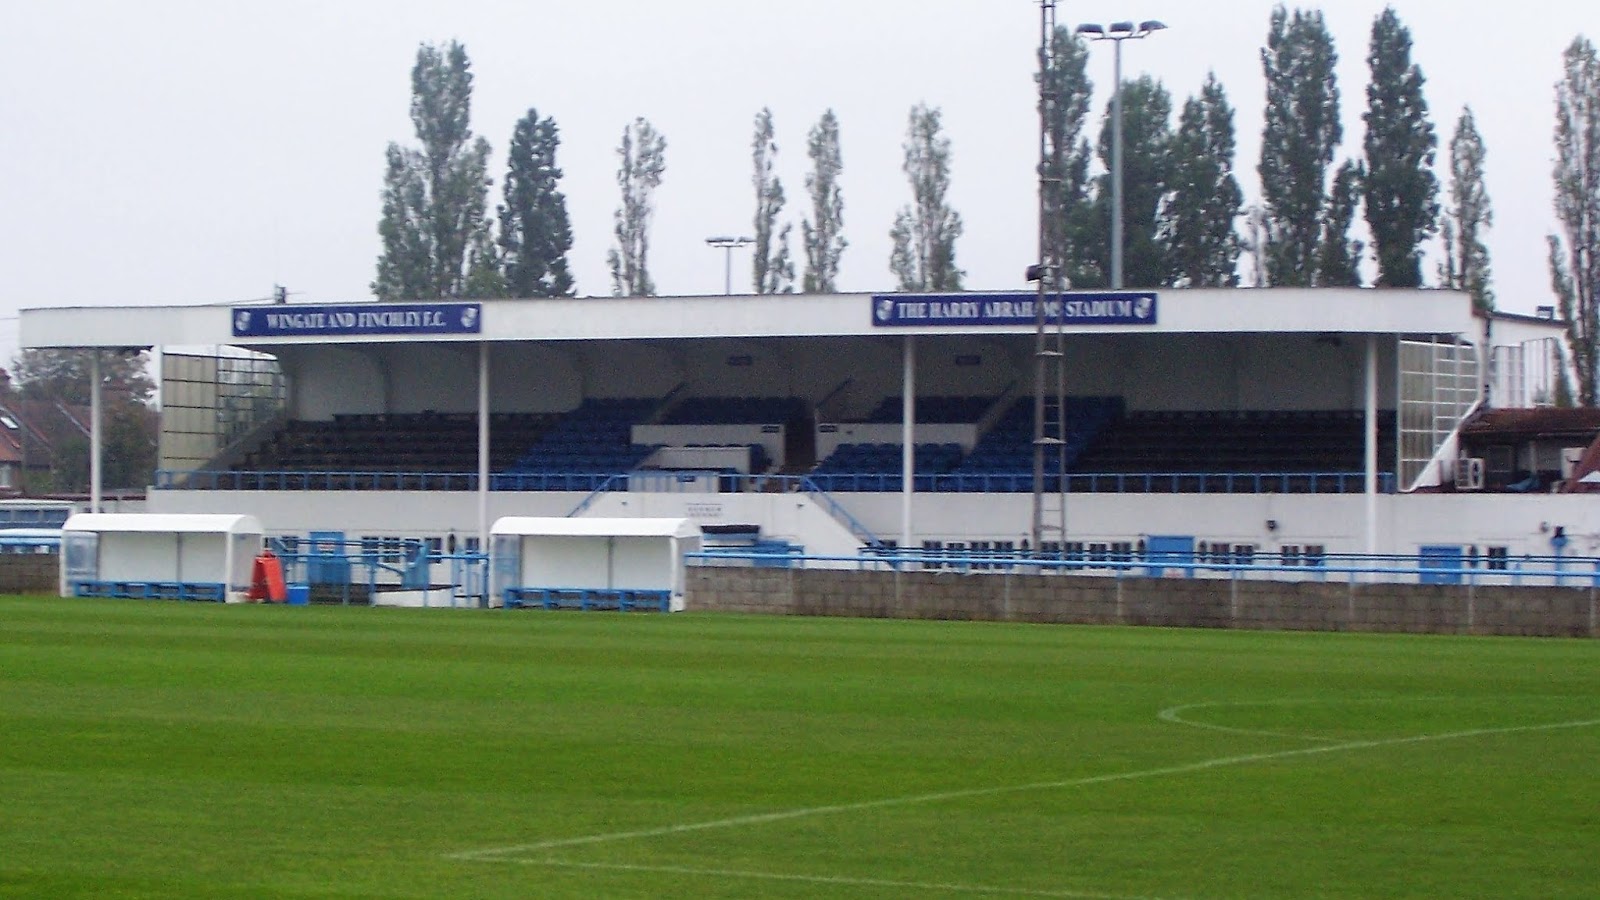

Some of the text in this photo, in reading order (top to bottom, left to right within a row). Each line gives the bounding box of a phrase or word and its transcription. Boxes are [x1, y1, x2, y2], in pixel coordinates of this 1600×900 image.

[896, 300, 1133, 319] THE HARRY ABRAHMS STADIUM
[266, 313, 325, 329] WINGATE
[327, 312, 356, 328] AND
[357, 311, 421, 328] FINCHLEY
